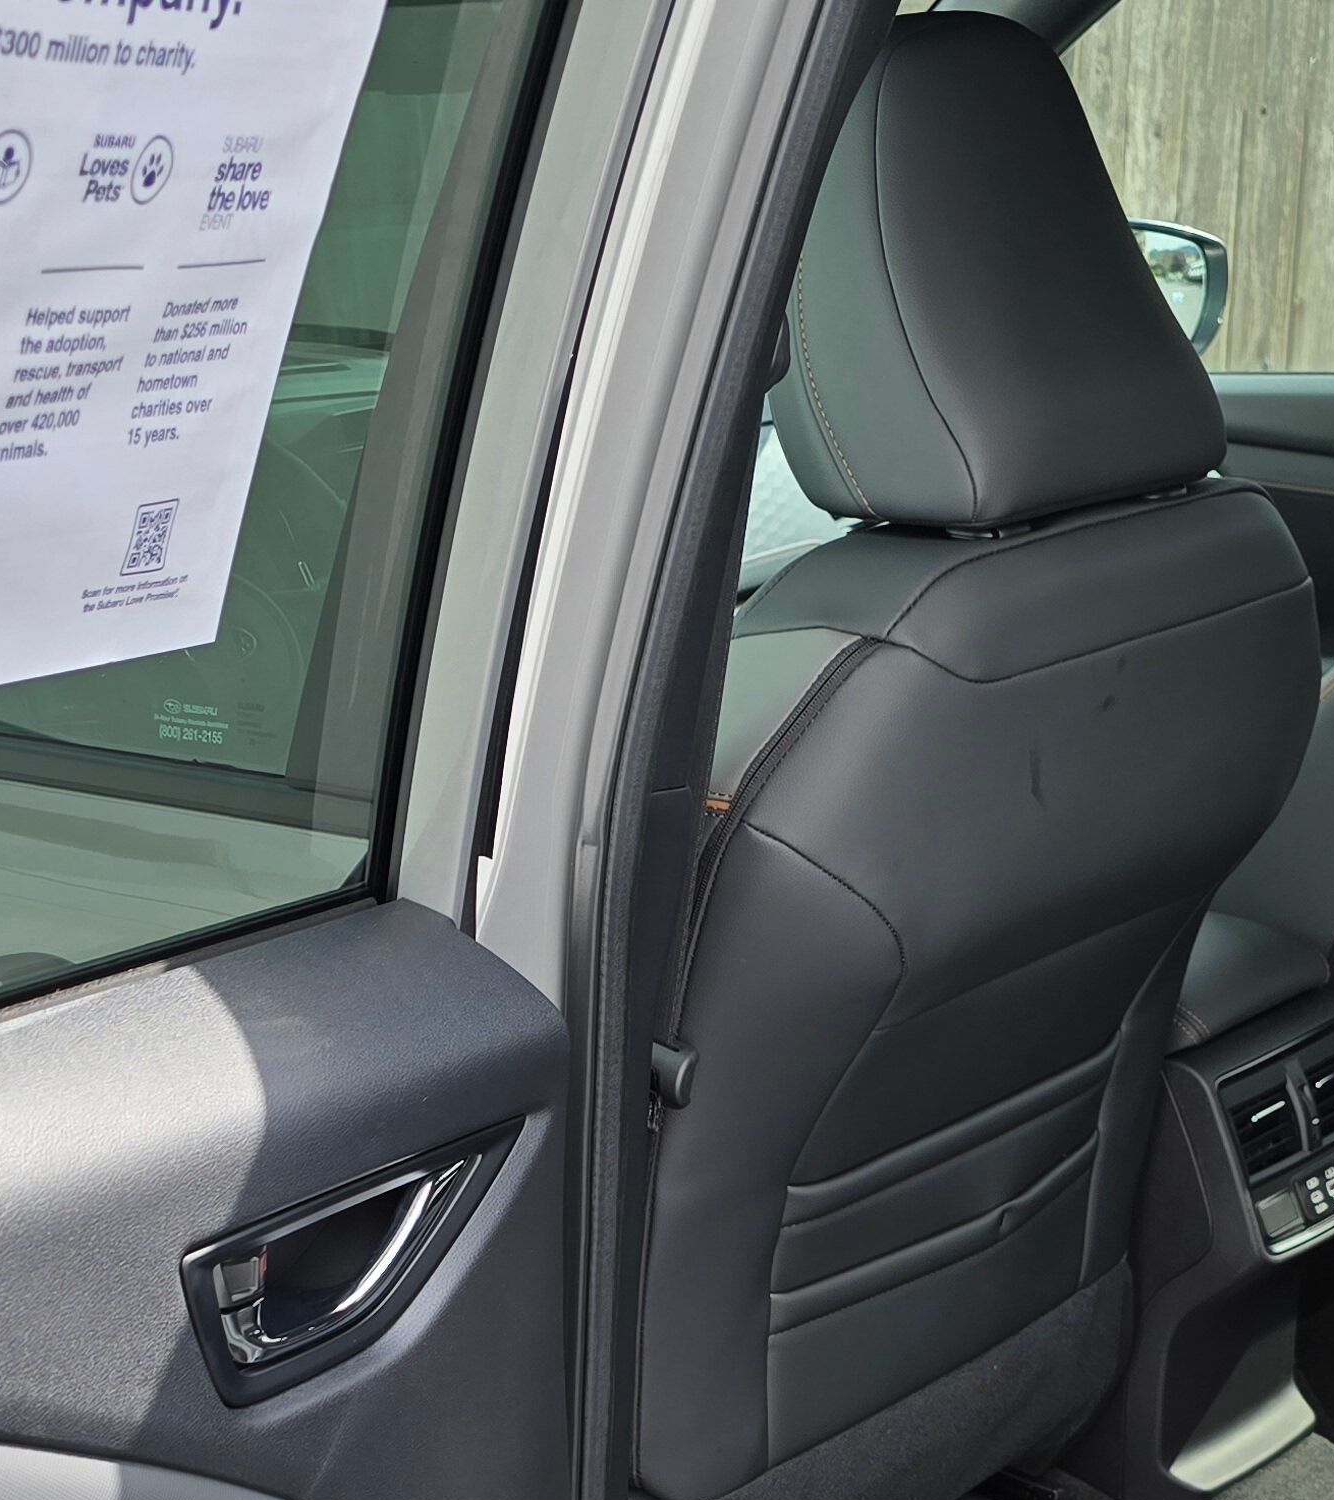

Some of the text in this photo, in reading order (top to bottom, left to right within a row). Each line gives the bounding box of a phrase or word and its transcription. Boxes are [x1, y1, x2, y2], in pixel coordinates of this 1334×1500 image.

[46, 31, 110, 66] million
[113, 38, 131, 65] to
[135, 39, 197, 76] charity.
[93, 133, 138, 150] SUBARU
[222, 135, 265, 154] SUBARU
[79, 152, 130, 177] Loves
[214, 155, 263, 183] share
[82, 179, 123, 202] Pets
[207, 184, 271, 213] the love
[198, 213, 235, 231] EVENT
[25, 304, 132, 331] Helped support
[162, 296, 240, 319] Donated more
[152, 318, 249, 344] than $256 million
[19, 332, 107, 357] the adoption,
[143, 343, 232, 368] to national and
[13, 355, 125, 384] rescue, transport
[5, 381, 93, 410] and health of
[135, 373, 199, 394] hometown
[30, 409, 81, 433] 420,000
[130, 398, 214, 420] charities over
[127, 426, 180, 449] 15 years.
[115, 584, 136, 594] more
